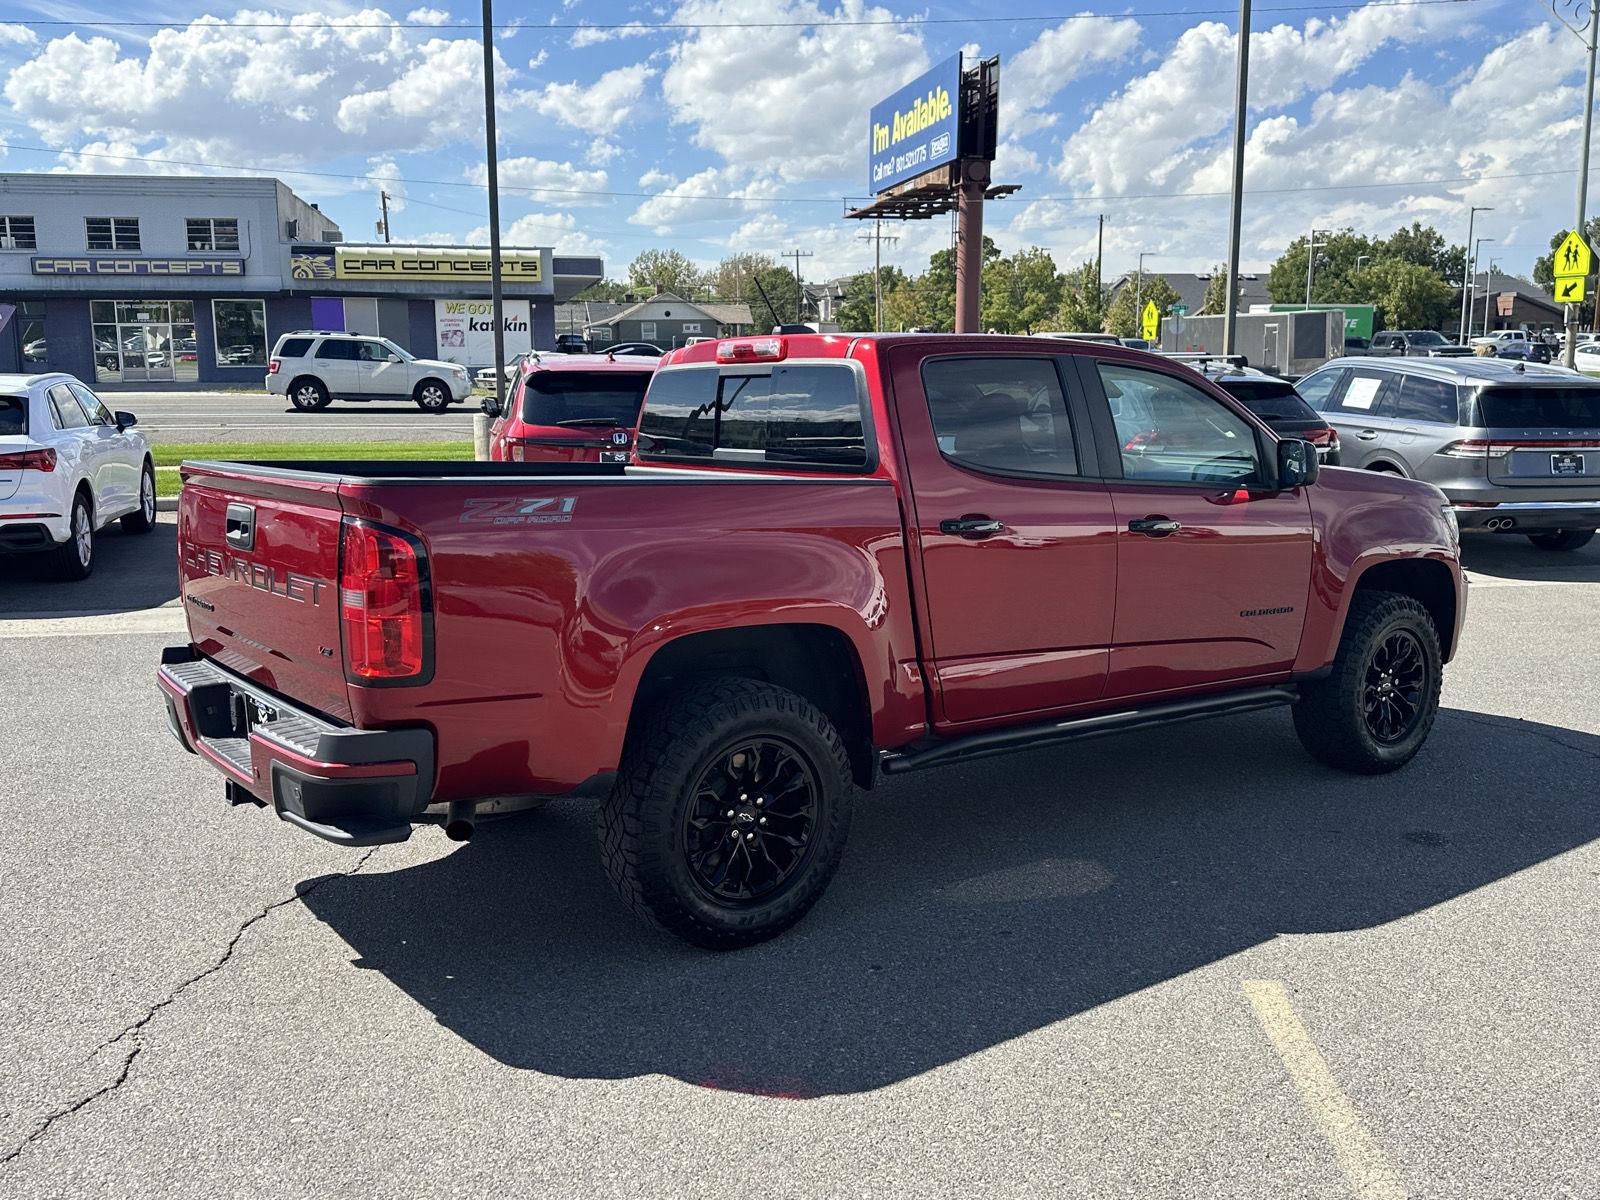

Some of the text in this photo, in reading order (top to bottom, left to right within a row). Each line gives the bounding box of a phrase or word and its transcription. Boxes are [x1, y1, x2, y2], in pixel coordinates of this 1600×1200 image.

[873, 85, 952, 155] I'm Available.
[873, 162, 883, 182] Call
[883, 156, 895, 178] me?
[35, 260, 241, 274] CAR CONCEPTS
[343, 259, 538, 272] CAR CONCEPTS
[445, 302, 494, 315] WE GOT
[468, 317, 528, 332] katkin
[460, 496, 579, 523] Z71
[493, 514, 573, 525] OFF ROAD
[185, 541, 327, 608] CHEVROLET
